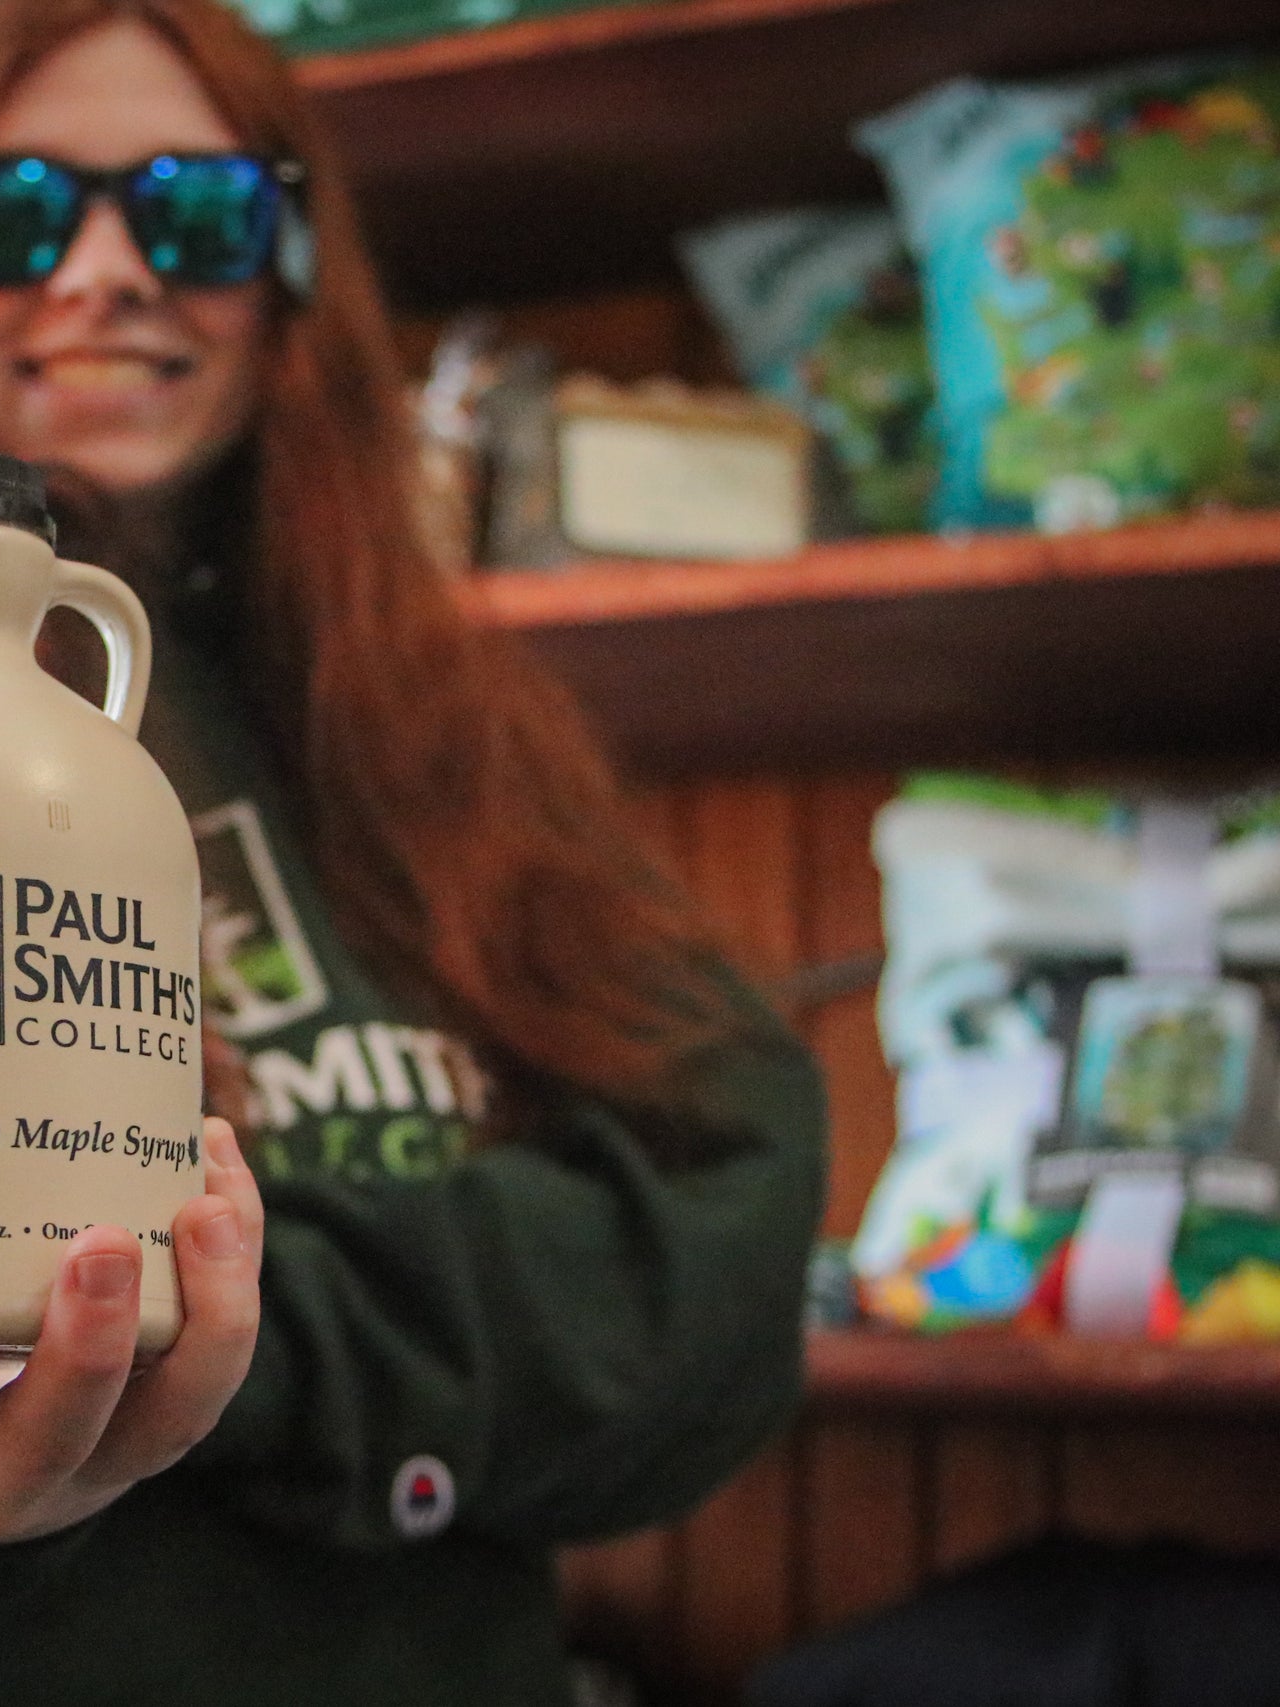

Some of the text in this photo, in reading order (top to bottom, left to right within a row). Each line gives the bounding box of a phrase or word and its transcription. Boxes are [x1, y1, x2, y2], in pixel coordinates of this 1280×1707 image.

[15, 878, 155, 951] PAUL
[14, 943, 195, 1026] SMITH'S
[16, 1017, 187, 1065] COLLEGE
[11, 1118, 115, 1161] Maple
[123, 1125, 186, 1172] Syrup
[42, 1222, 78, 1241] One
[150, 1229, 171, 1248] 946
